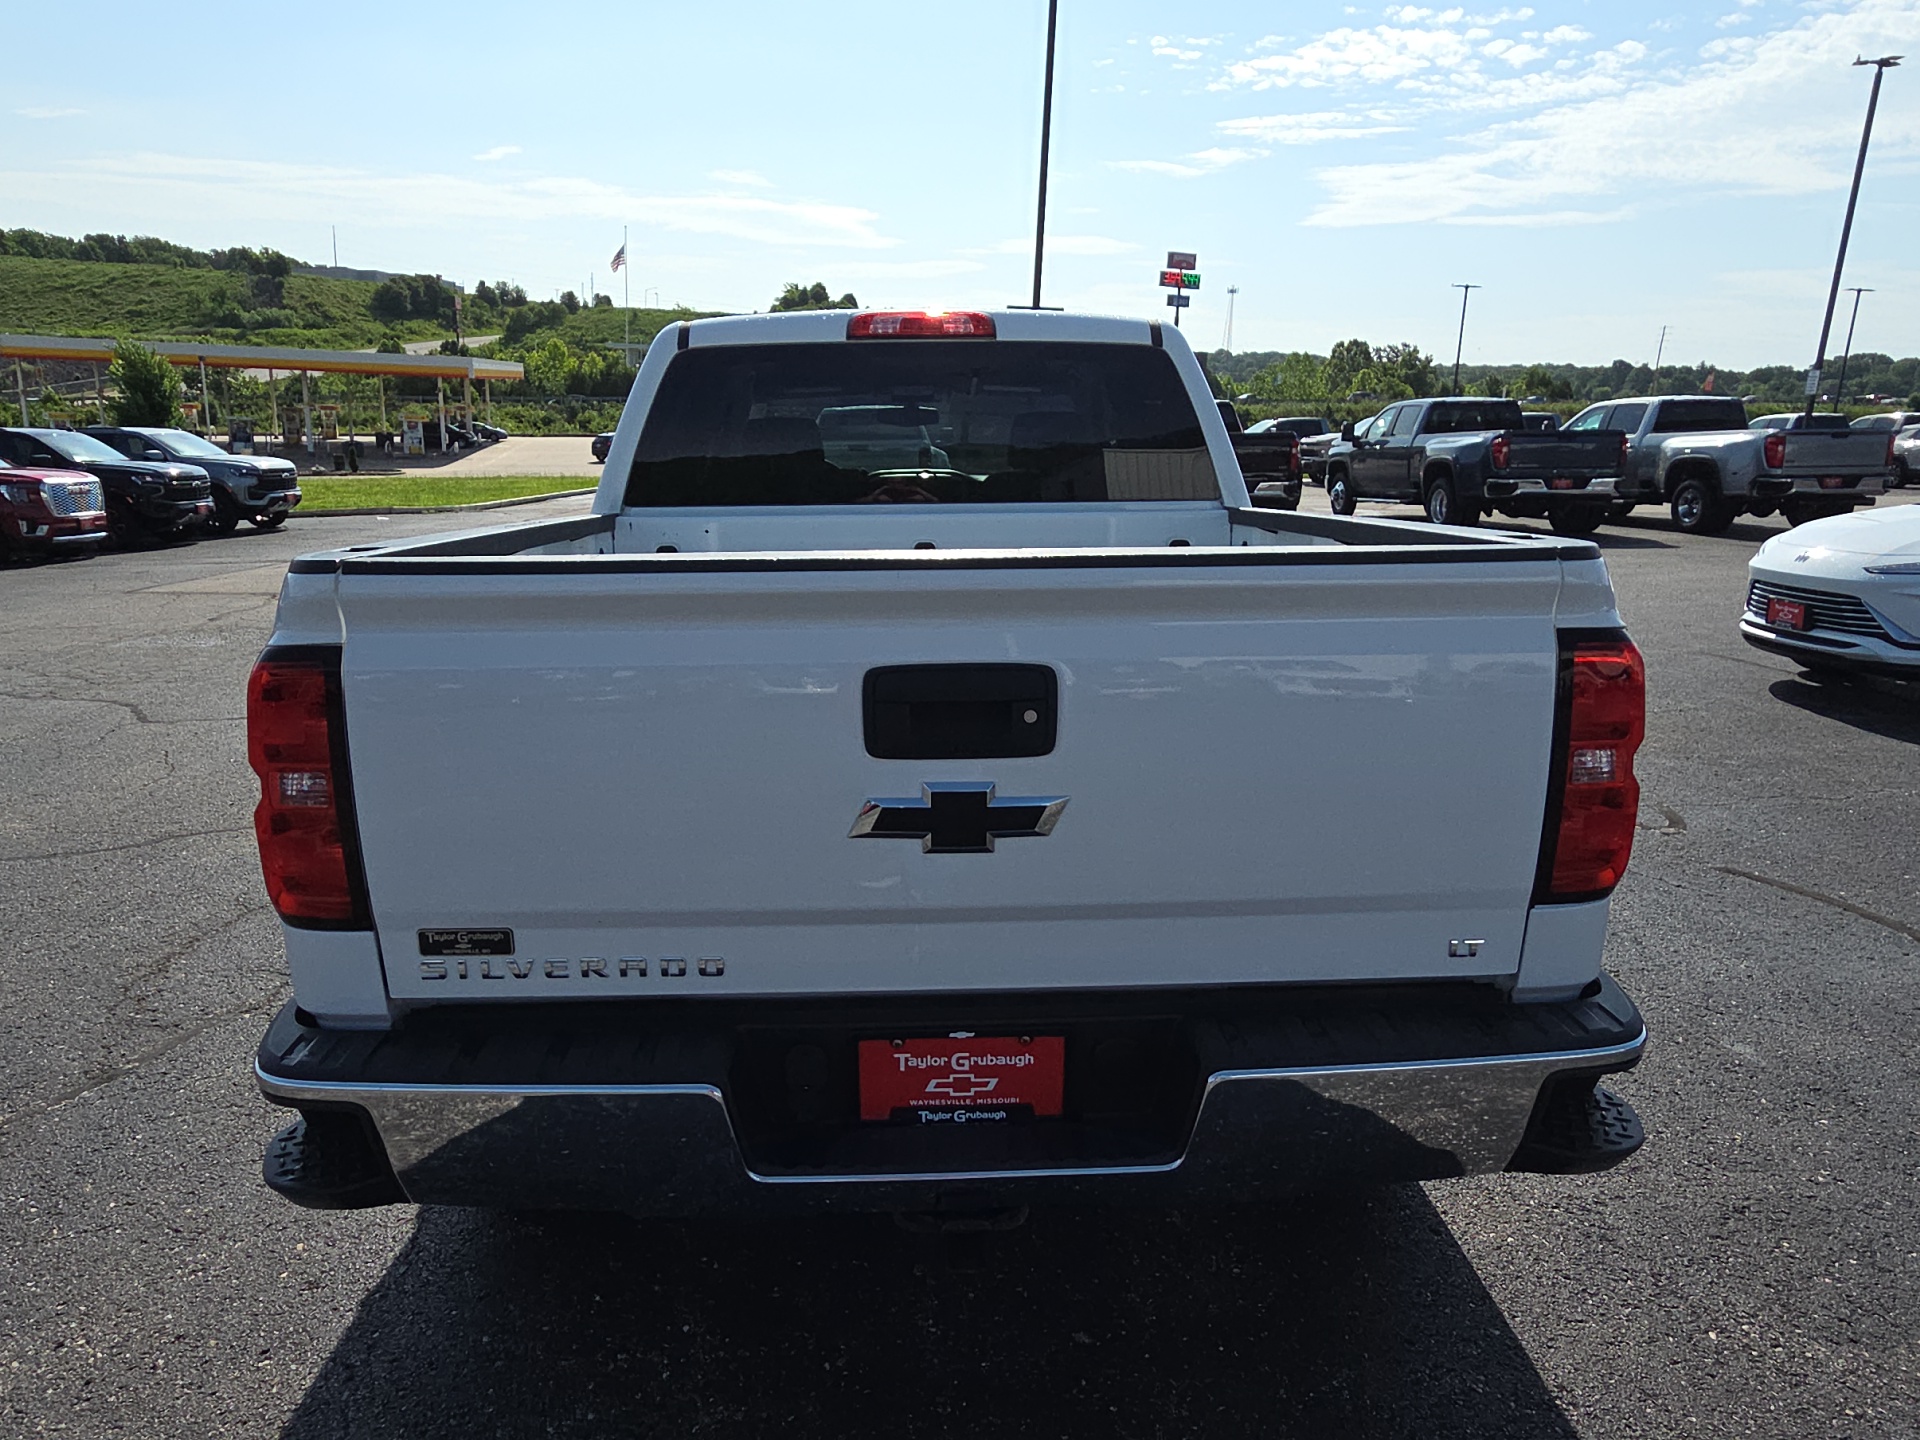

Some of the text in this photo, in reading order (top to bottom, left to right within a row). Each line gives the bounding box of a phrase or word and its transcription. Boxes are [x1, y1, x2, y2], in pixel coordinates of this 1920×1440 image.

[425, 932, 456, 943] Taylor
[1448, 939, 1485, 957] LT
[419, 956, 725, 981] SILVERADO
[893, 1052, 1034, 1071] Taylor Grubaugh
[909, 1097, 1020, 1106] WAYNESVILLE, MISSOURI
[917, 1110, 1007, 1123] Taylor Grubaugh
